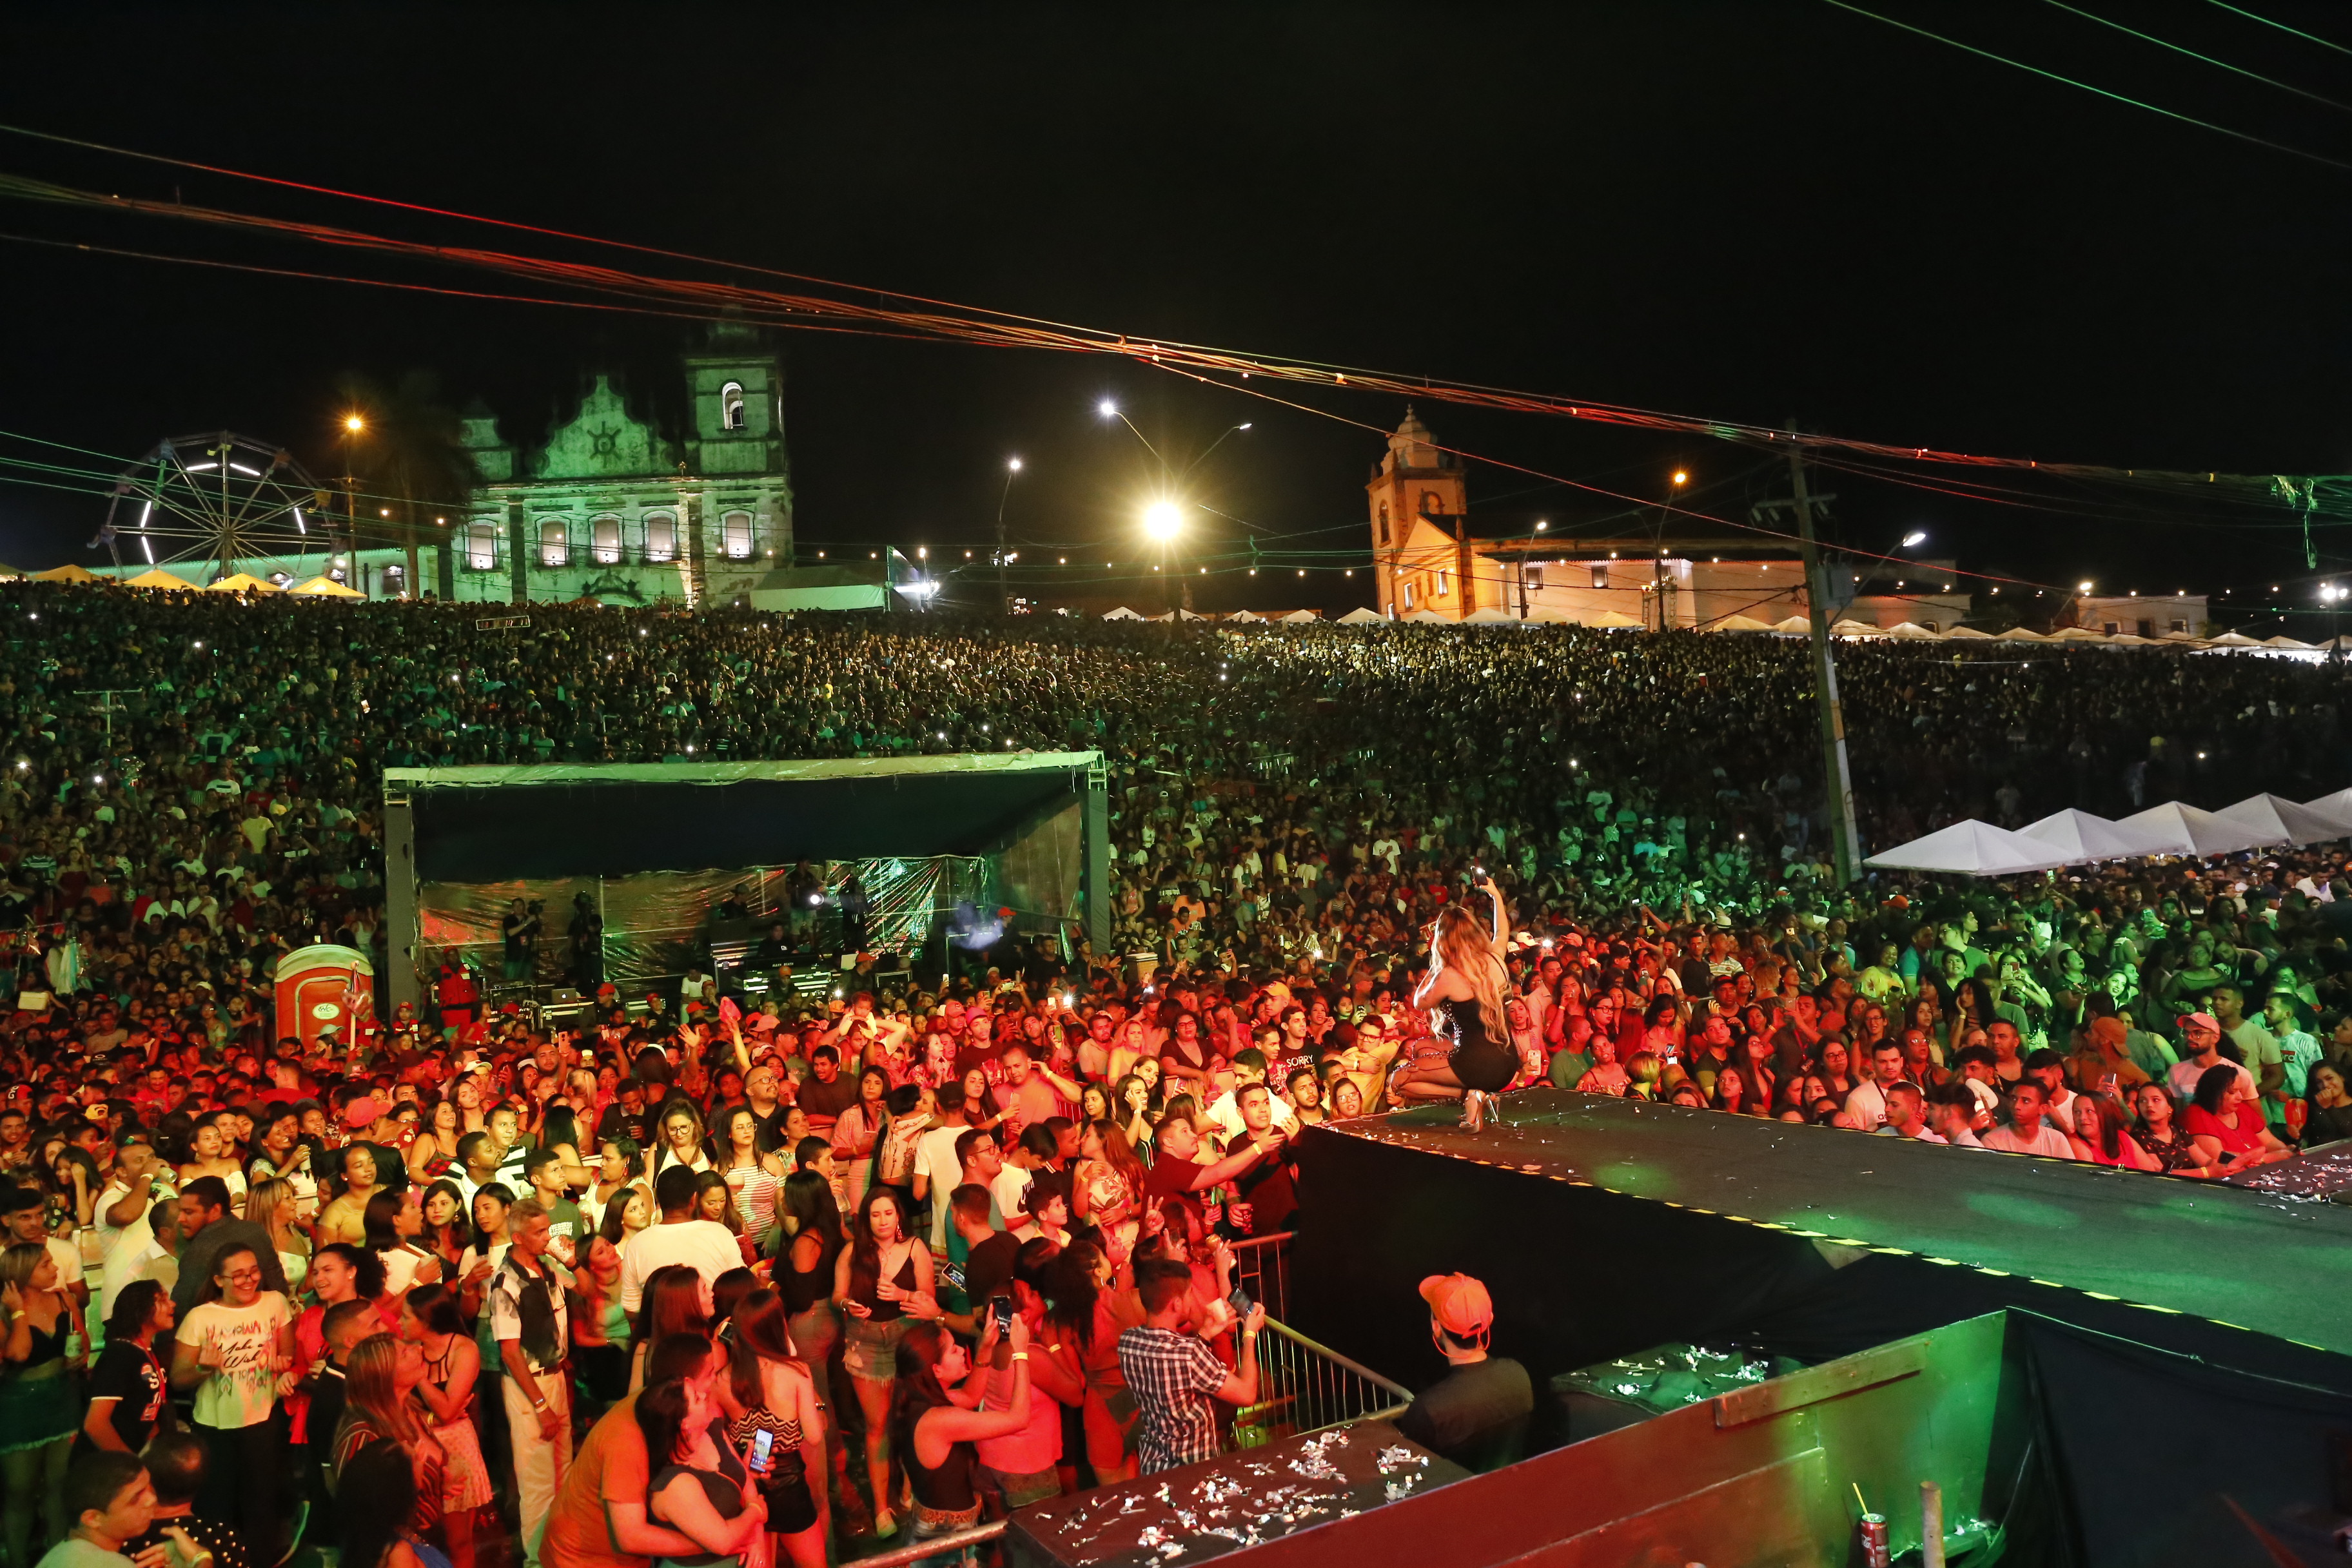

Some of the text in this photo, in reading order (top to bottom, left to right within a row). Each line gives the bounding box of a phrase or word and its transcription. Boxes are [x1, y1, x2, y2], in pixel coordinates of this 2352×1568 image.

[1286, 1054, 1313, 1068] SORRY
[218, 1338, 254, 1355] Make
[223, 1349, 261, 1369] Wish
